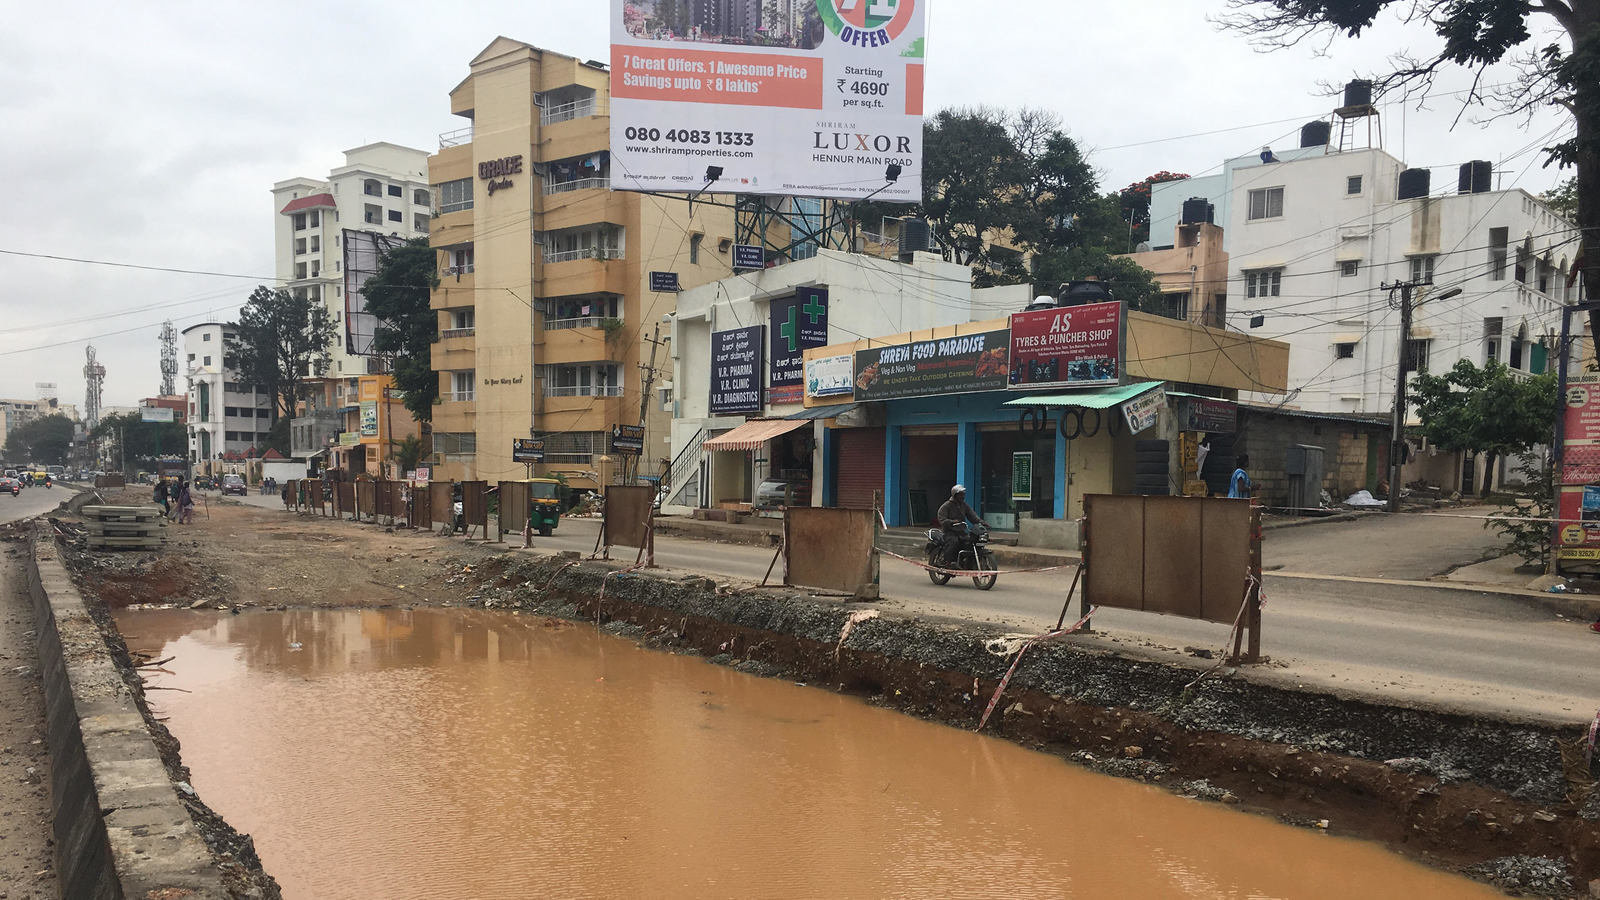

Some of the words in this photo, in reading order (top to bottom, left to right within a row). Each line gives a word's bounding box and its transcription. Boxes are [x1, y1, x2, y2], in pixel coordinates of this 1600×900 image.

[841, 26, 889, 47] OFFER
[623, 55, 630, 68] 7
[632, 56, 665, 71] Great
[668, 57, 707, 74] Offers.
[709, 61, 715, 74] 1
[717, 61, 774, 77] Awesome
[777, 64, 807, 79] Price
[845, 66, 883, 78] Starting
[623, 72, 671, 89] Savings
[674, 76, 701, 91] upto
[715, 79, 723, 91] 8
[843, 99, 858, 107] per
[860, 99, 884, 108] sq.ft.
[816, 121, 856, 129] SHRIRAM
[625, 127, 660, 141] 080
[665, 129, 711, 144] 4083
[716, 131, 754, 146] 1333
[813, 131, 912, 153] LUXOR
[626, 145, 753, 158] www.shriramproperties.com
[478, 155, 523, 179] GRACE
[812, 154, 854, 164] HENNUR
[857, 156, 881, 165] MAIN
[884, 157, 913, 167] ROAD
[1050, 313, 1072, 333] AS
[1015, 336, 1039, 347] TYRES
[1040, 335, 1047, 345] &
[1049, 331, 1087, 344] PUNCHER
[1089, 329, 1113, 341] SHOP
[879, 345, 910, 365] SHREYA
[912, 343, 936, 360] FOOD
[938, 335, 985, 356] PARADISE
[718, 367, 729, 378] V.R.
[730, 364, 753, 376] PHARMA
[773, 371, 783, 381] V.R.
[784, 370, 803, 380] PHARM
[881, 367, 891, 376] Veg
[890, 366, 896, 374] &
[896, 365, 906, 374] Non
[906, 364, 916, 374] Veg
[721, 380, 731, 390] V.R.
[733, 378, 750, 390] CLINIC
[712, 394, 723, 404] V.R.
[724, 391, 758, 403] DIAGNOSTICS
